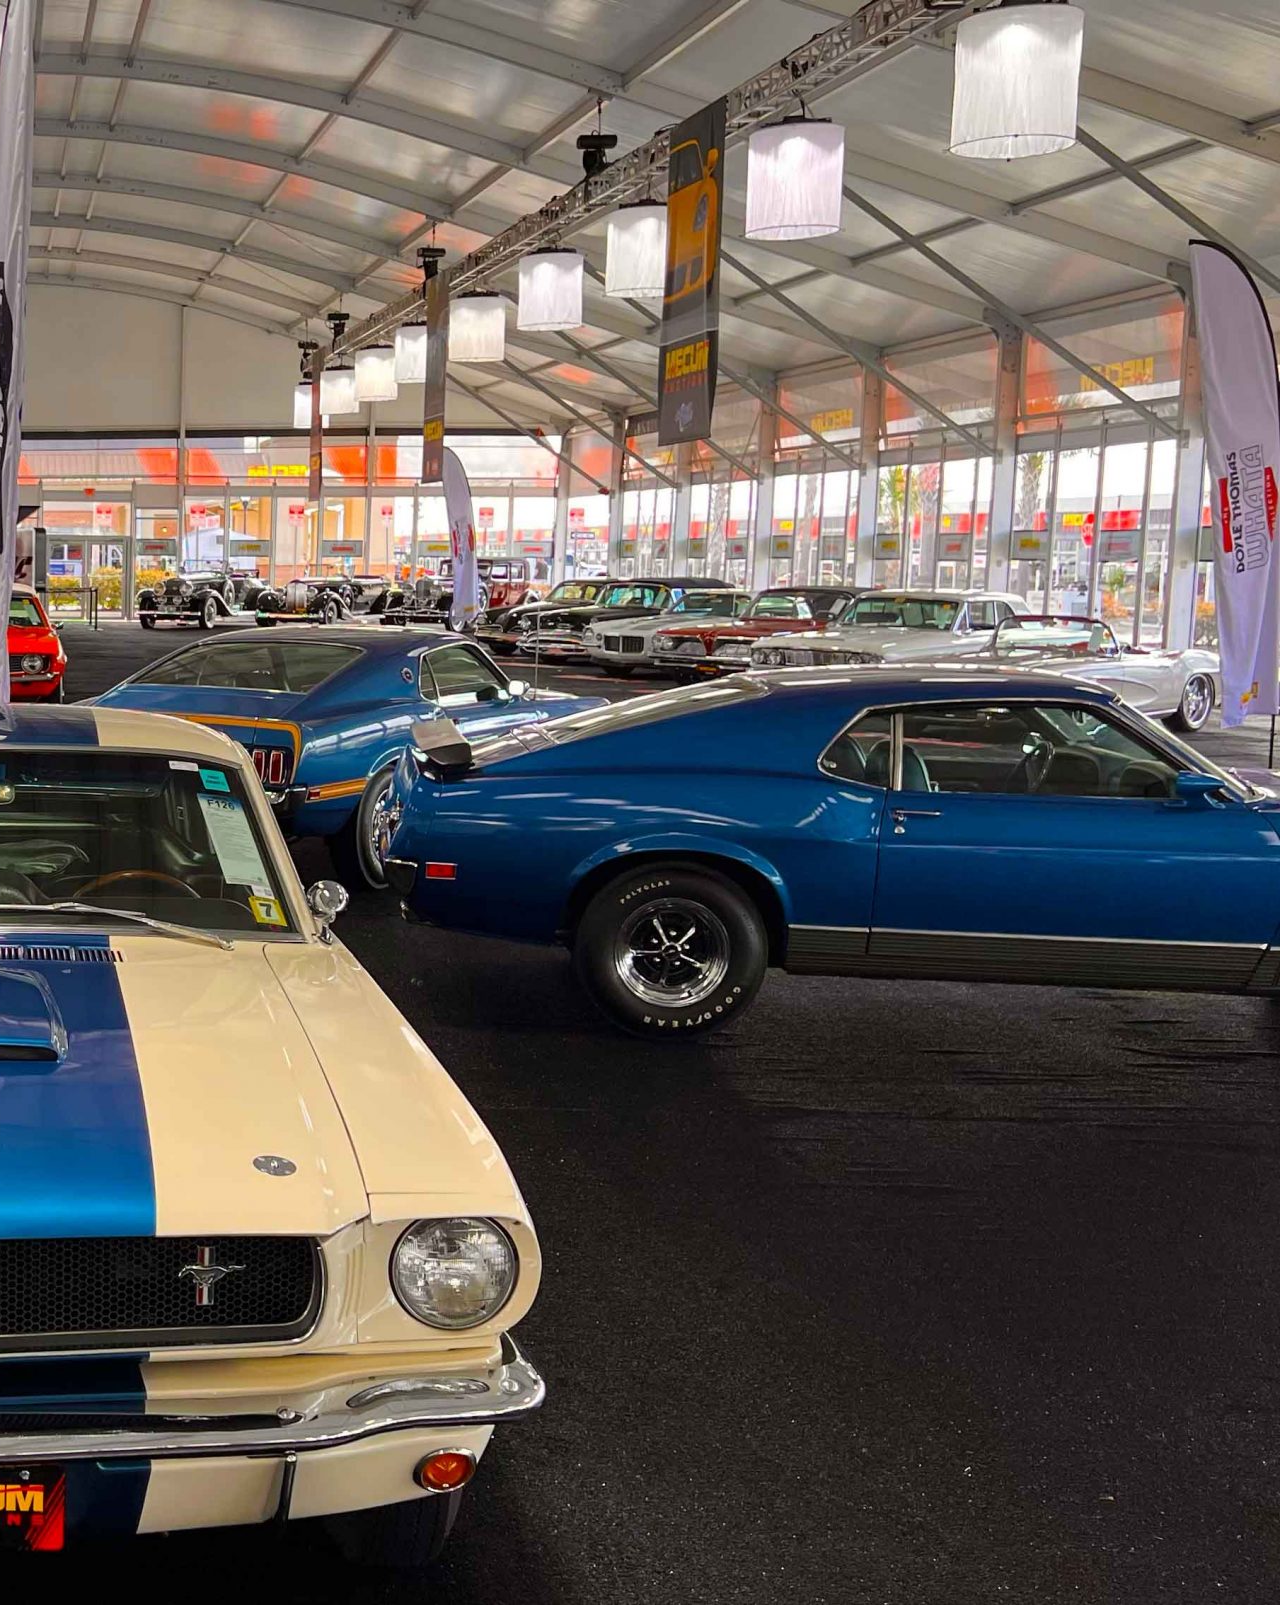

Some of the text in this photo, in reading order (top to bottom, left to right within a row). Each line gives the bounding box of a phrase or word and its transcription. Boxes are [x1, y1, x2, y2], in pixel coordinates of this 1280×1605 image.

[665, 340, 709, 380] MECUM
[1226, 451, 1245, 574] DOYLE THOMAS
[1239, 443, 1270, 571] WHATA
[258, 902, 273, 918] 7
[643, 985, 742, 1028] GOODYEAR
